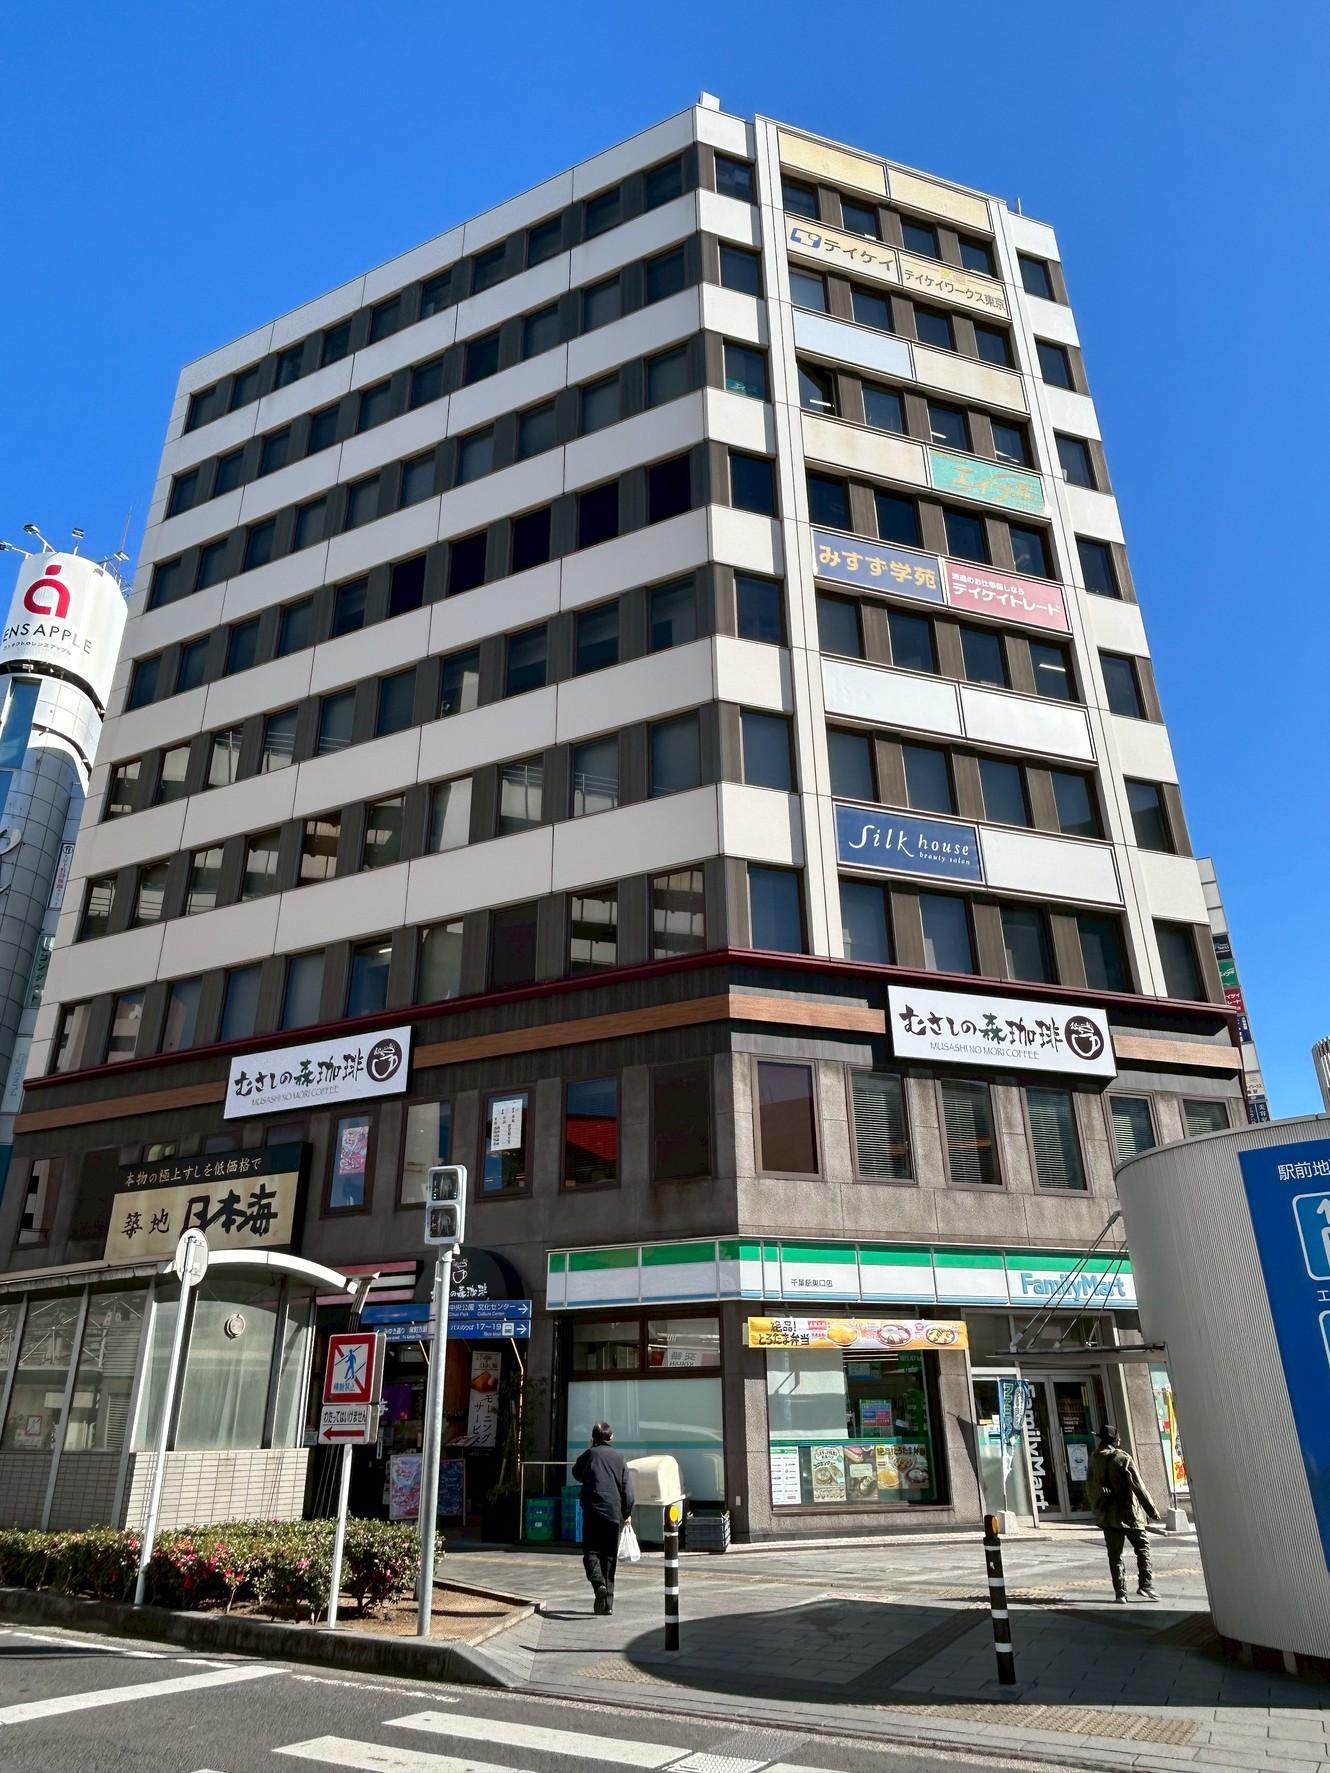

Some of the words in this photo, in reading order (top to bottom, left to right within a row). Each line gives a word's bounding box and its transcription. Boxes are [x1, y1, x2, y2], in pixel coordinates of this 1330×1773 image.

[824, 238, 894, 271] テイケイ
[819, 545, 937, 589] みすず学苑
[952, 582, 1062, 616] テイケイトレード
[848, 825, 915, 857] Silk
[919, 834, 969, 855] house
[920, 851, 945, 863] beauty
[950, 857, 970, 865] salon
[899, 1005, 1063, 1051] むさしの森珈琲
[234, 1048, 364, 1096] むさしの森珈琲
[126, 1157, 262, 1187] 本物の極上すしを低価格で
[1278, 1159, 1330, 1181] 駅前地
[180, 1183, 278, 1237] 日本海
[1021, 1272, 1126, 1301] FamilyMart
[477, 1303, 516, 1311] 文化センター
[481, 1394, 493, 1444] モーニング
